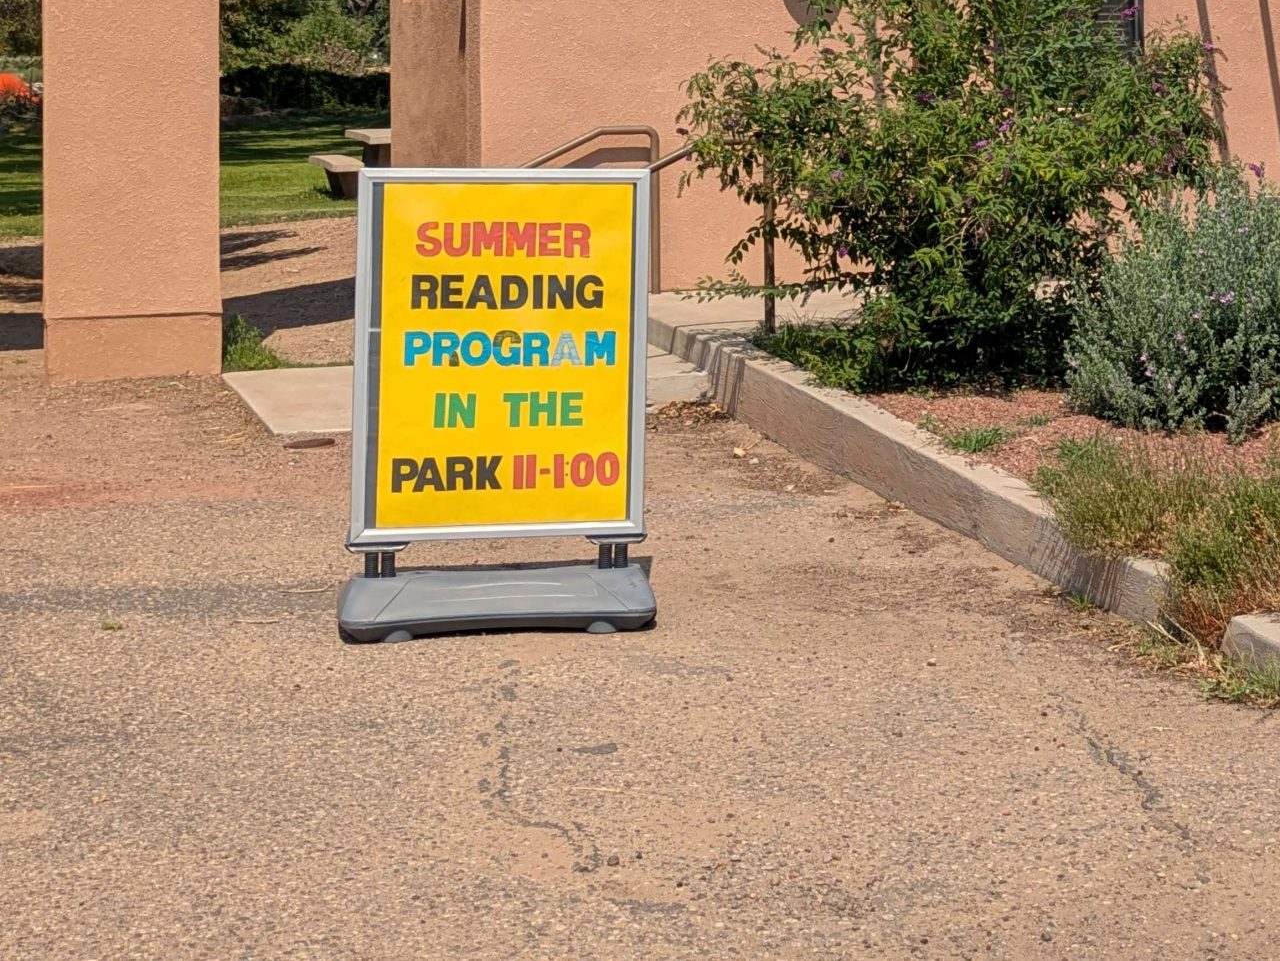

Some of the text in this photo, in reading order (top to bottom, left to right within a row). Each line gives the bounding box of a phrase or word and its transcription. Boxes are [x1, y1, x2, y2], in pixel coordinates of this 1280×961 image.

[416, 221, 591, 258] SUMMER
[411, 274, 604, 309] READING
[404, 329, 616, 367] PROGRAM
[433, 391, 583, 428] IN THE
[391, 451, 620, 493] PARK 11-1:00
